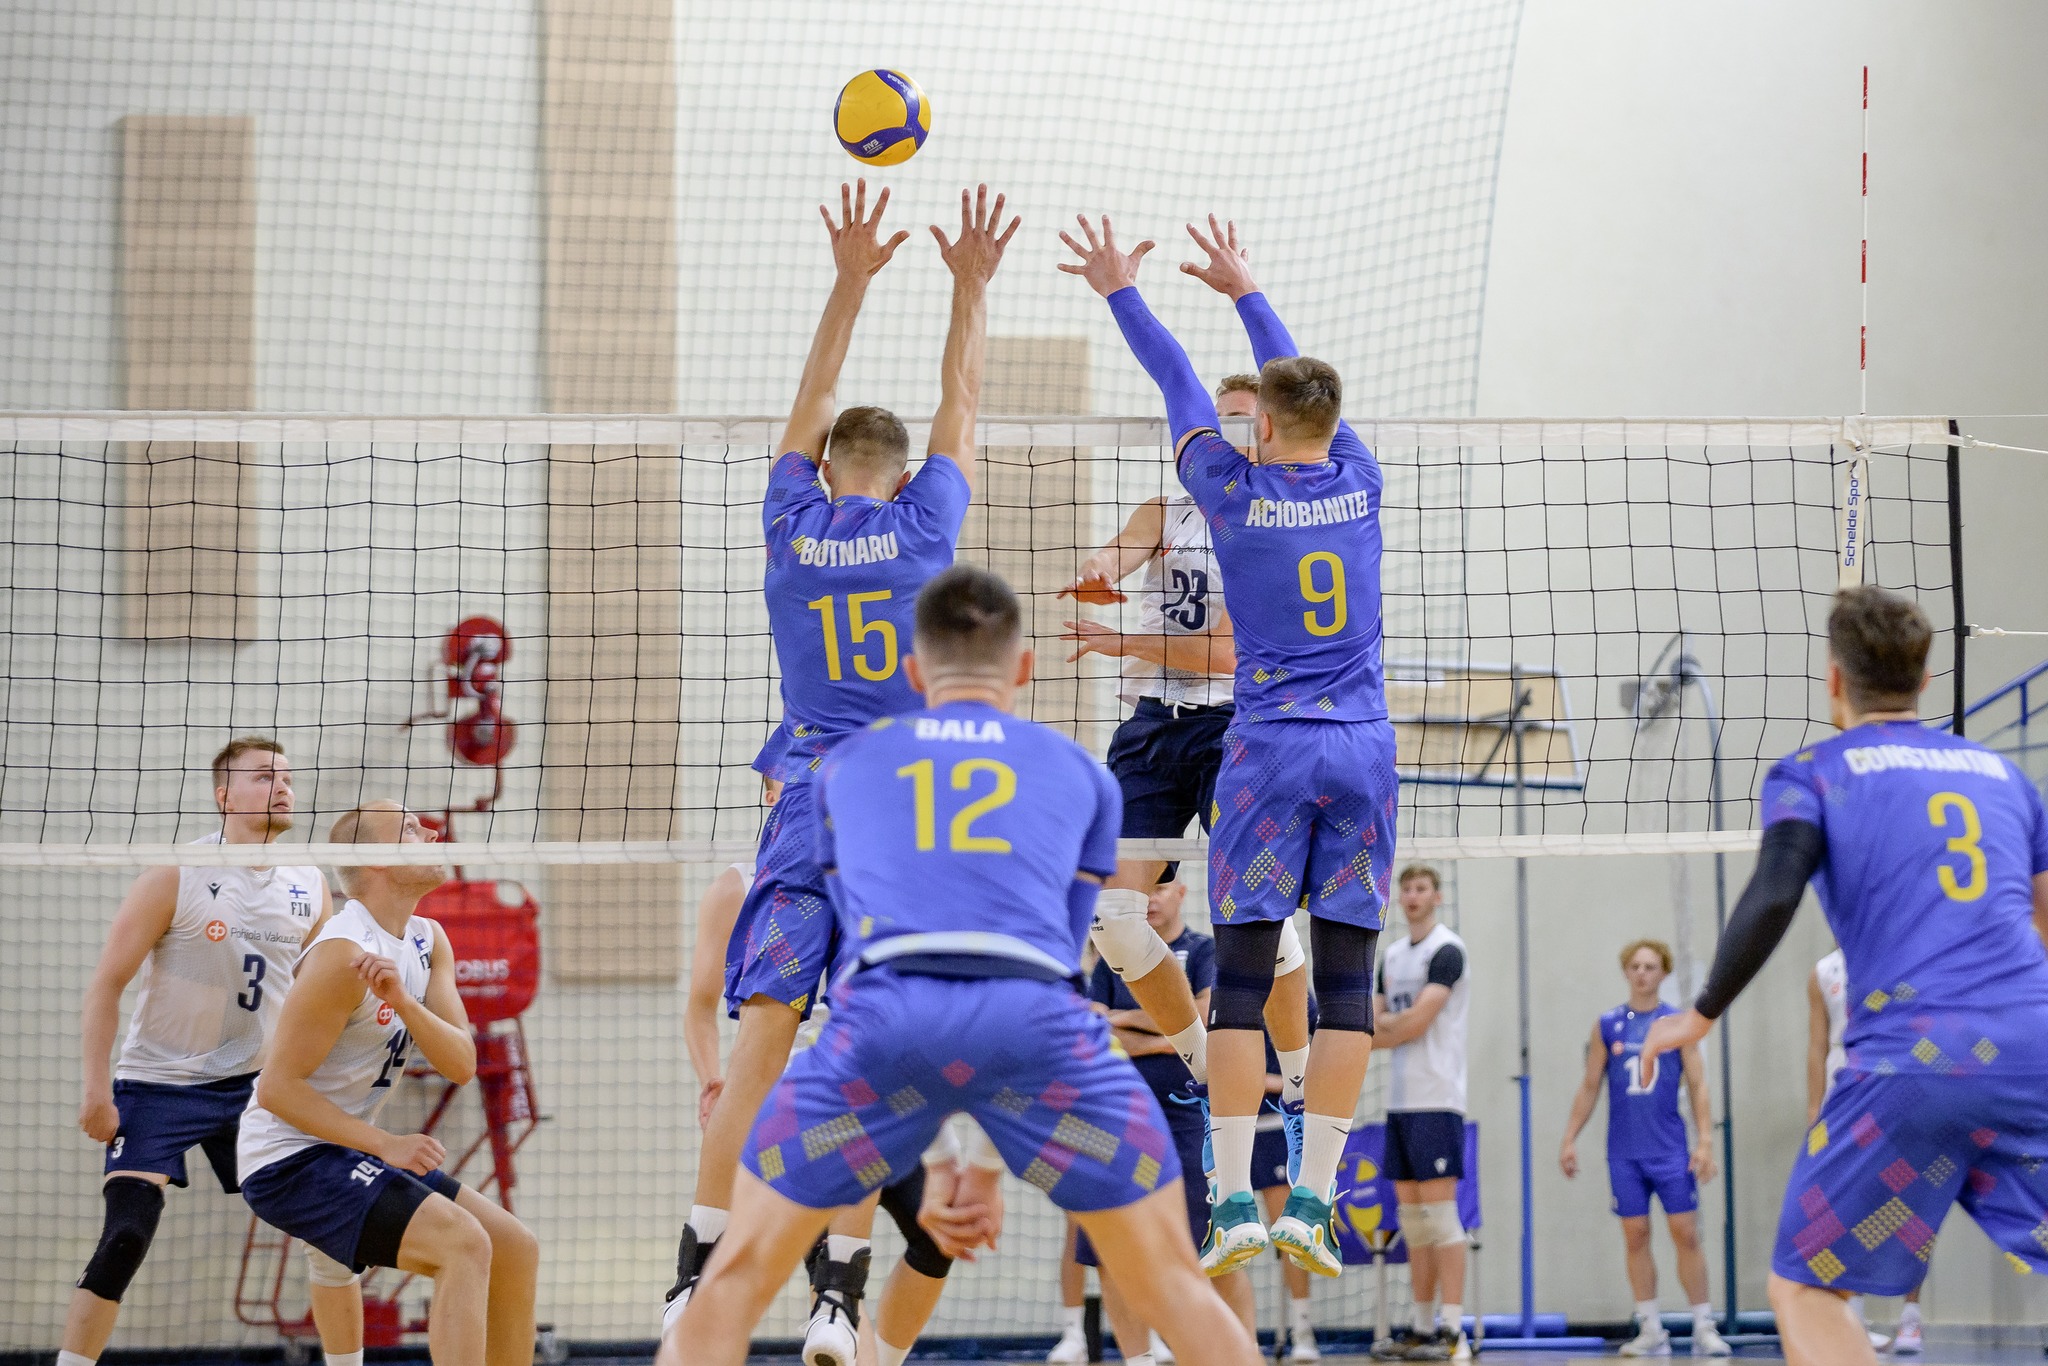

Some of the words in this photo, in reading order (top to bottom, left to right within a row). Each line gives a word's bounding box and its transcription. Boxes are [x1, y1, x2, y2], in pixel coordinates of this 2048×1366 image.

[1848, 473, 1861, 506] Spor
[799, 531, 899, 568] BOTNARU
[1844, 509, 1858, 567] Schelde
[1160, 568, 1208, 630] 23
[1298, 551, 1348, 637] 9
[808, 589, 898, 681] 15
[915, 718, 1006, 743] BALA
[896, 758, 1017, 854] 12
[1927, 791, 1988, 903] 3
[291, 902, 311, 917] FIN
[230, 926, 261, 941] Pohjola
[264, 930, 302, 944] Vakuutus
[237, 953, 267, 1012] 3
[455, 958, 510, 981] OBUS
[111, 1136, 124, 1160] 3
[350, 1160, 384, 1187] 14
